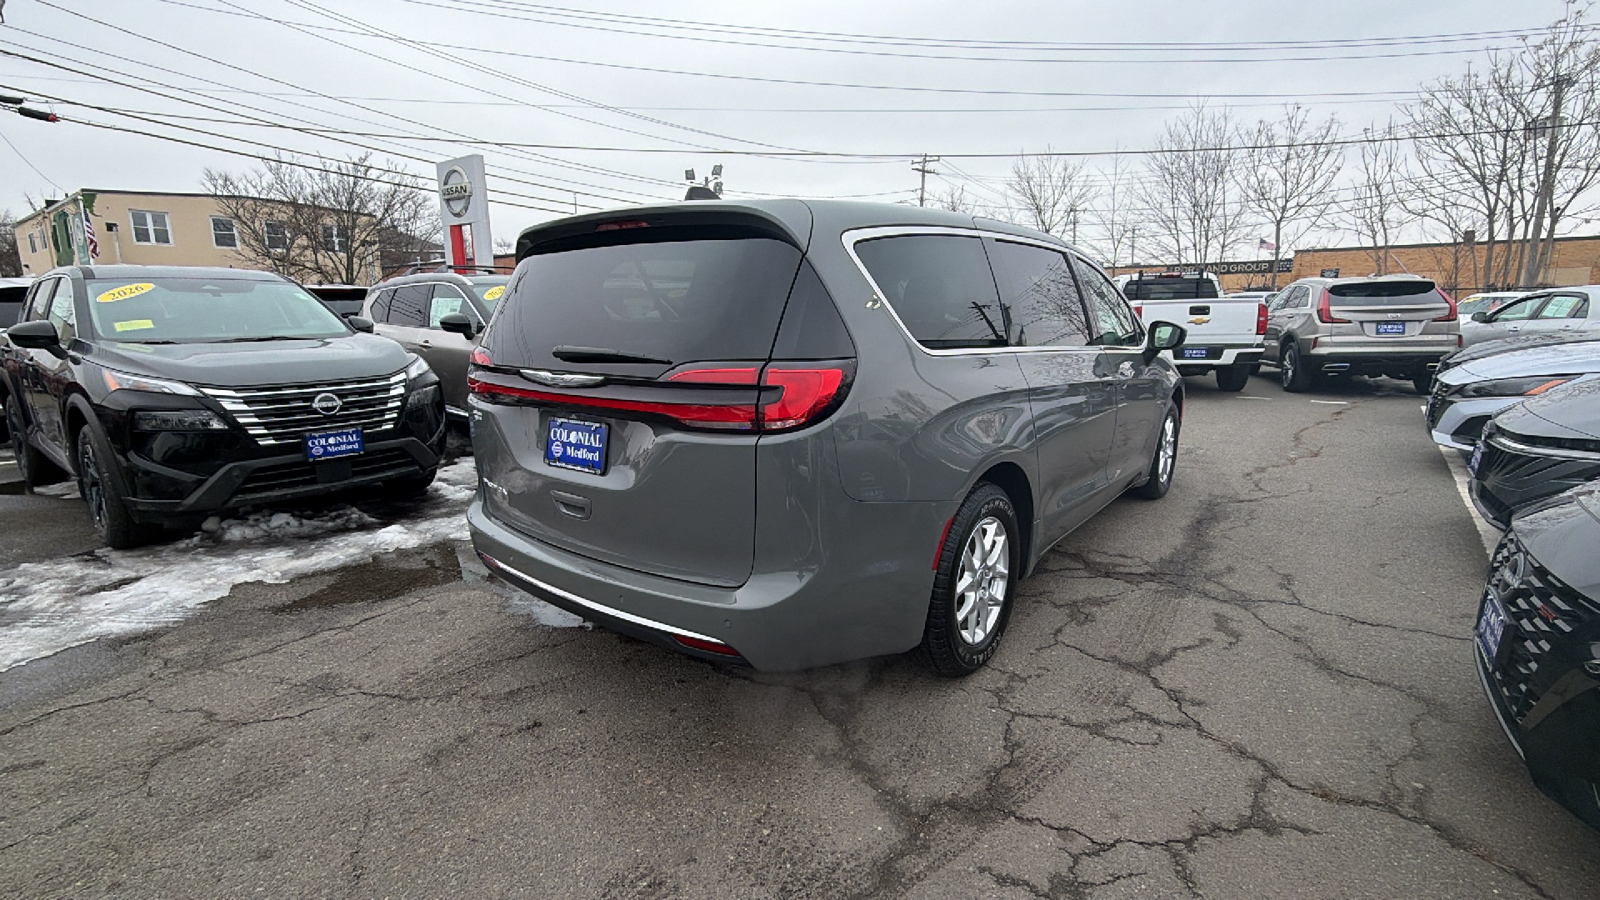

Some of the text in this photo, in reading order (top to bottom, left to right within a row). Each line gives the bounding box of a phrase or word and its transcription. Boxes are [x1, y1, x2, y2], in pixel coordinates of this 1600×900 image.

[1229, 263, 1269, 273] GROUP
[108, 285, 145, 300] 2026
[308, 434, 360, 448] COLONIAL
[550, 427, 603, 448] COLONIAL
[327, 442, 359, 453] Medford
[566, 445, 599, 462] Medford
